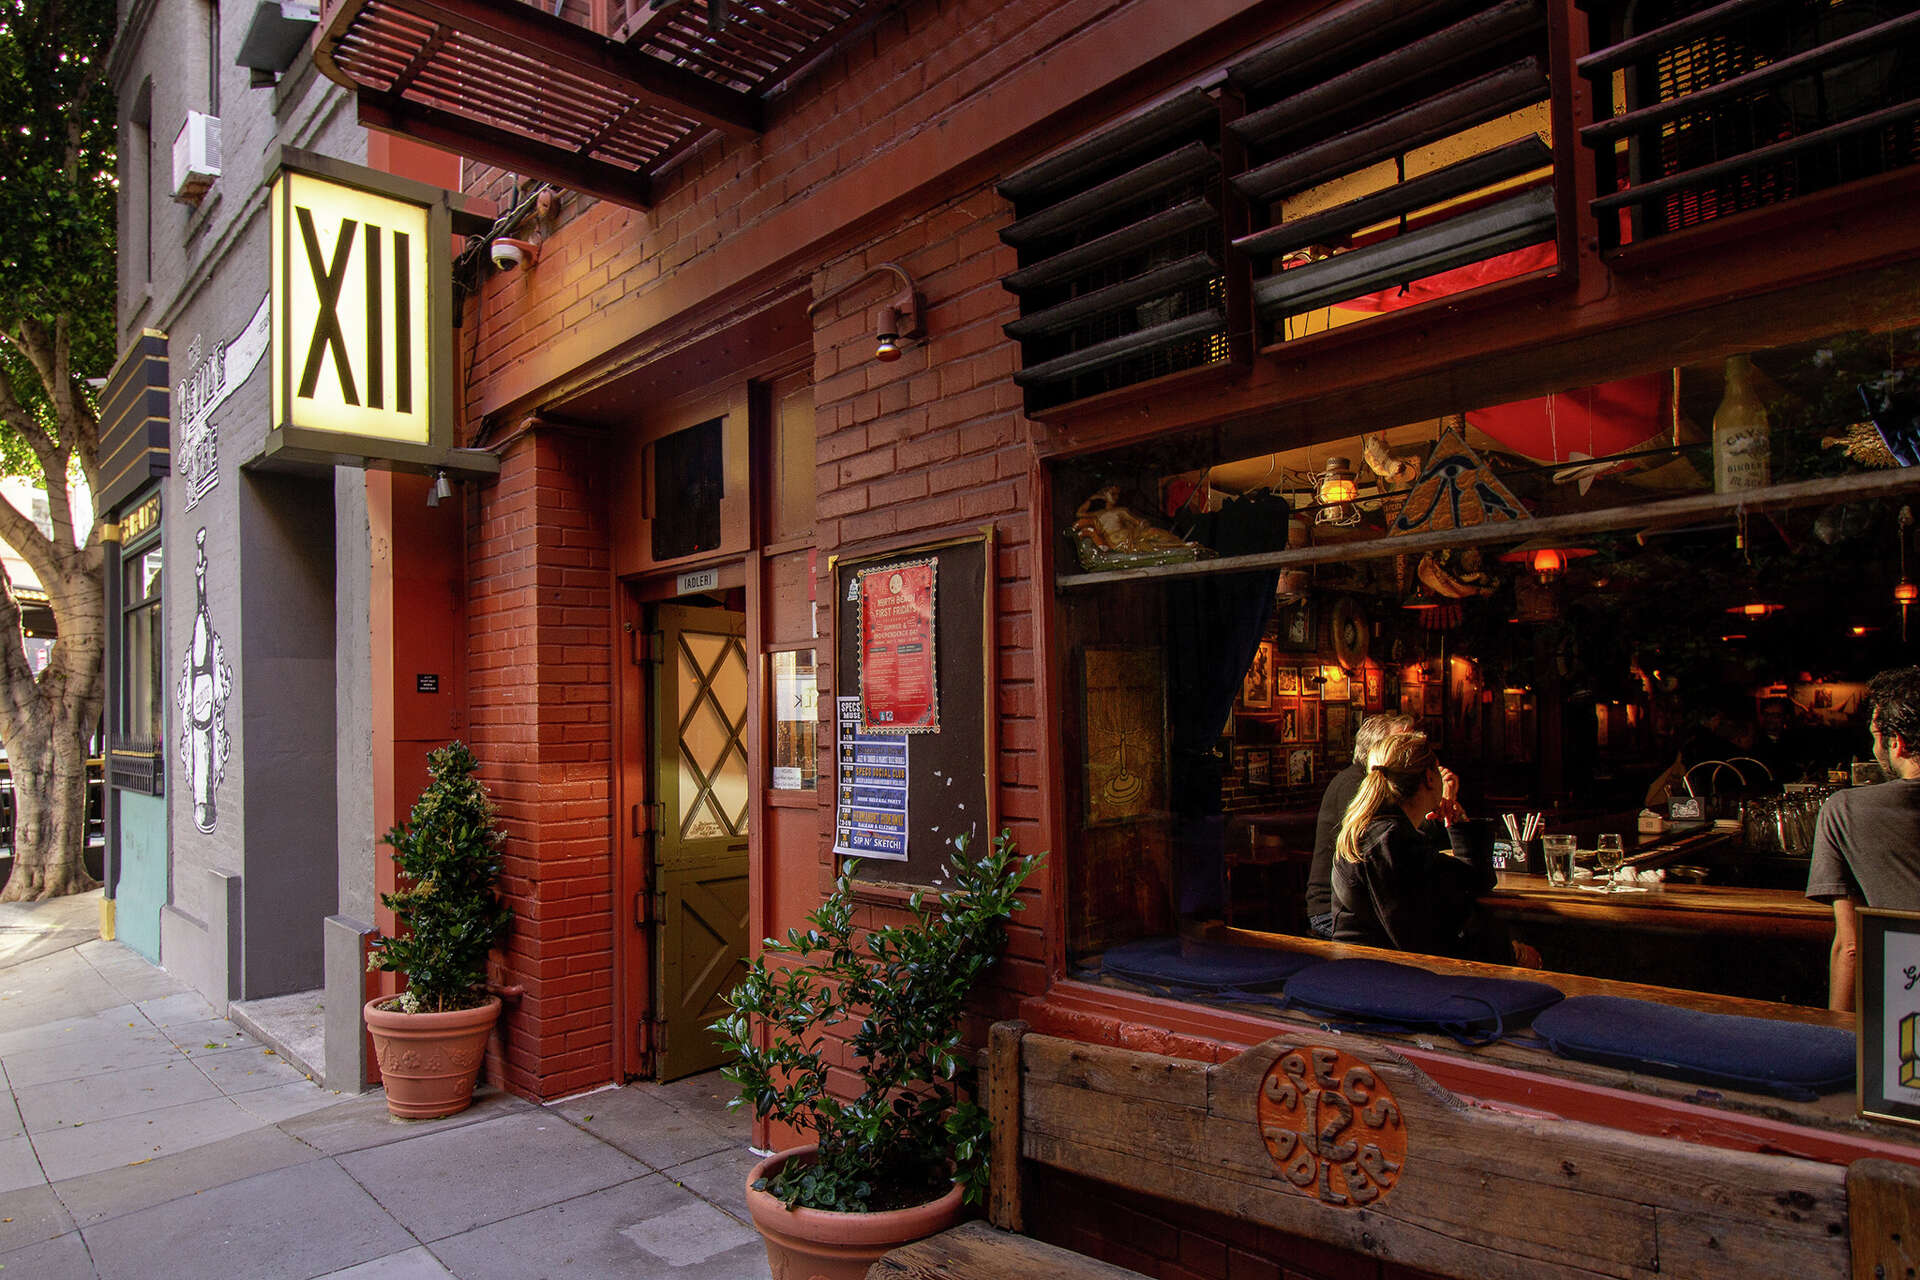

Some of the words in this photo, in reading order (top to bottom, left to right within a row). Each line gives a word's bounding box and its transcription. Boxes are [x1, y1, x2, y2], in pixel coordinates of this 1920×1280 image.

[295, 206, 412, 414] XII
[841, 702, 860, 712] SPECS
[853, 836, 864, 845] SIP
[1265, 1048, 1400, 1129] SPECS
[1302, 1089, 1358, 1162] 12
[1264, 1126, 1401, 1204] ADLER
